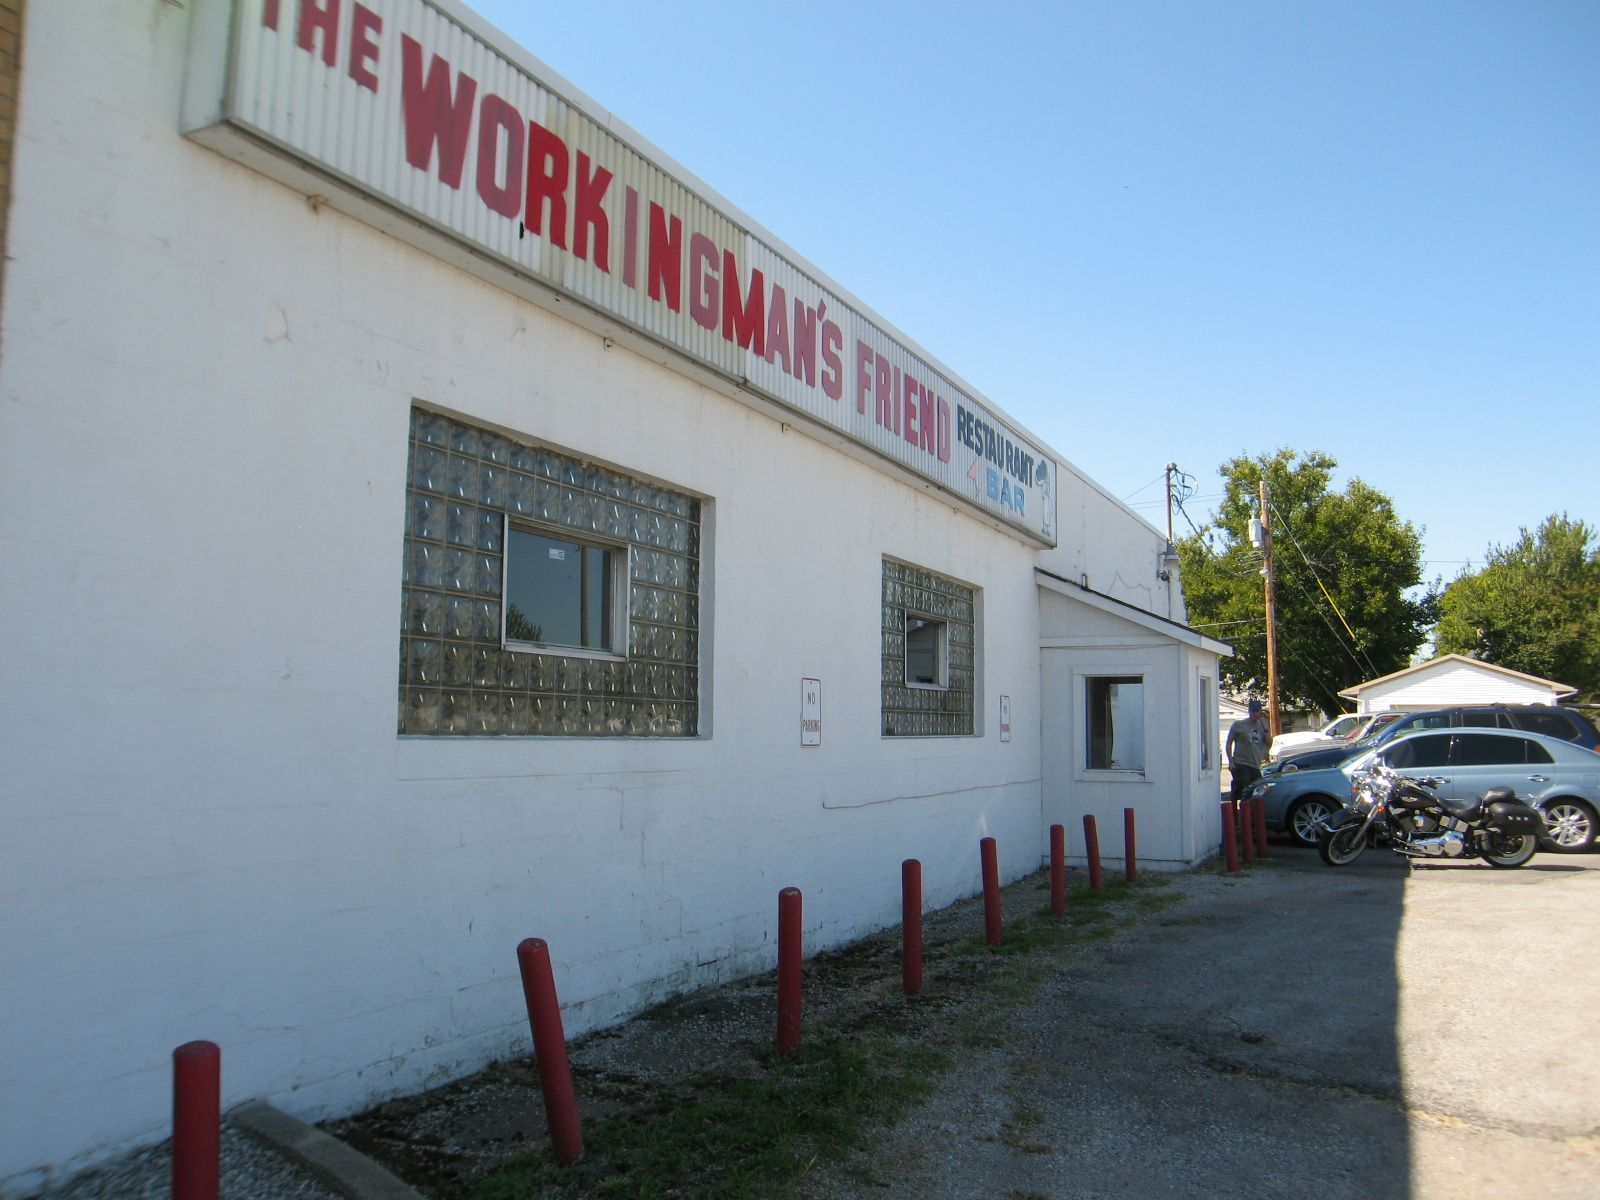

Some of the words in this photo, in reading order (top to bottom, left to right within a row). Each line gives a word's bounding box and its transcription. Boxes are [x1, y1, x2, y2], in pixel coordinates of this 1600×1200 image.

[857, 339, 951, 464] FRIEND
[957, 404, 1034, 488] RESTAURANT
[986, 467, 1024, 516] BAR
[807, 692, 816, 705] NO
